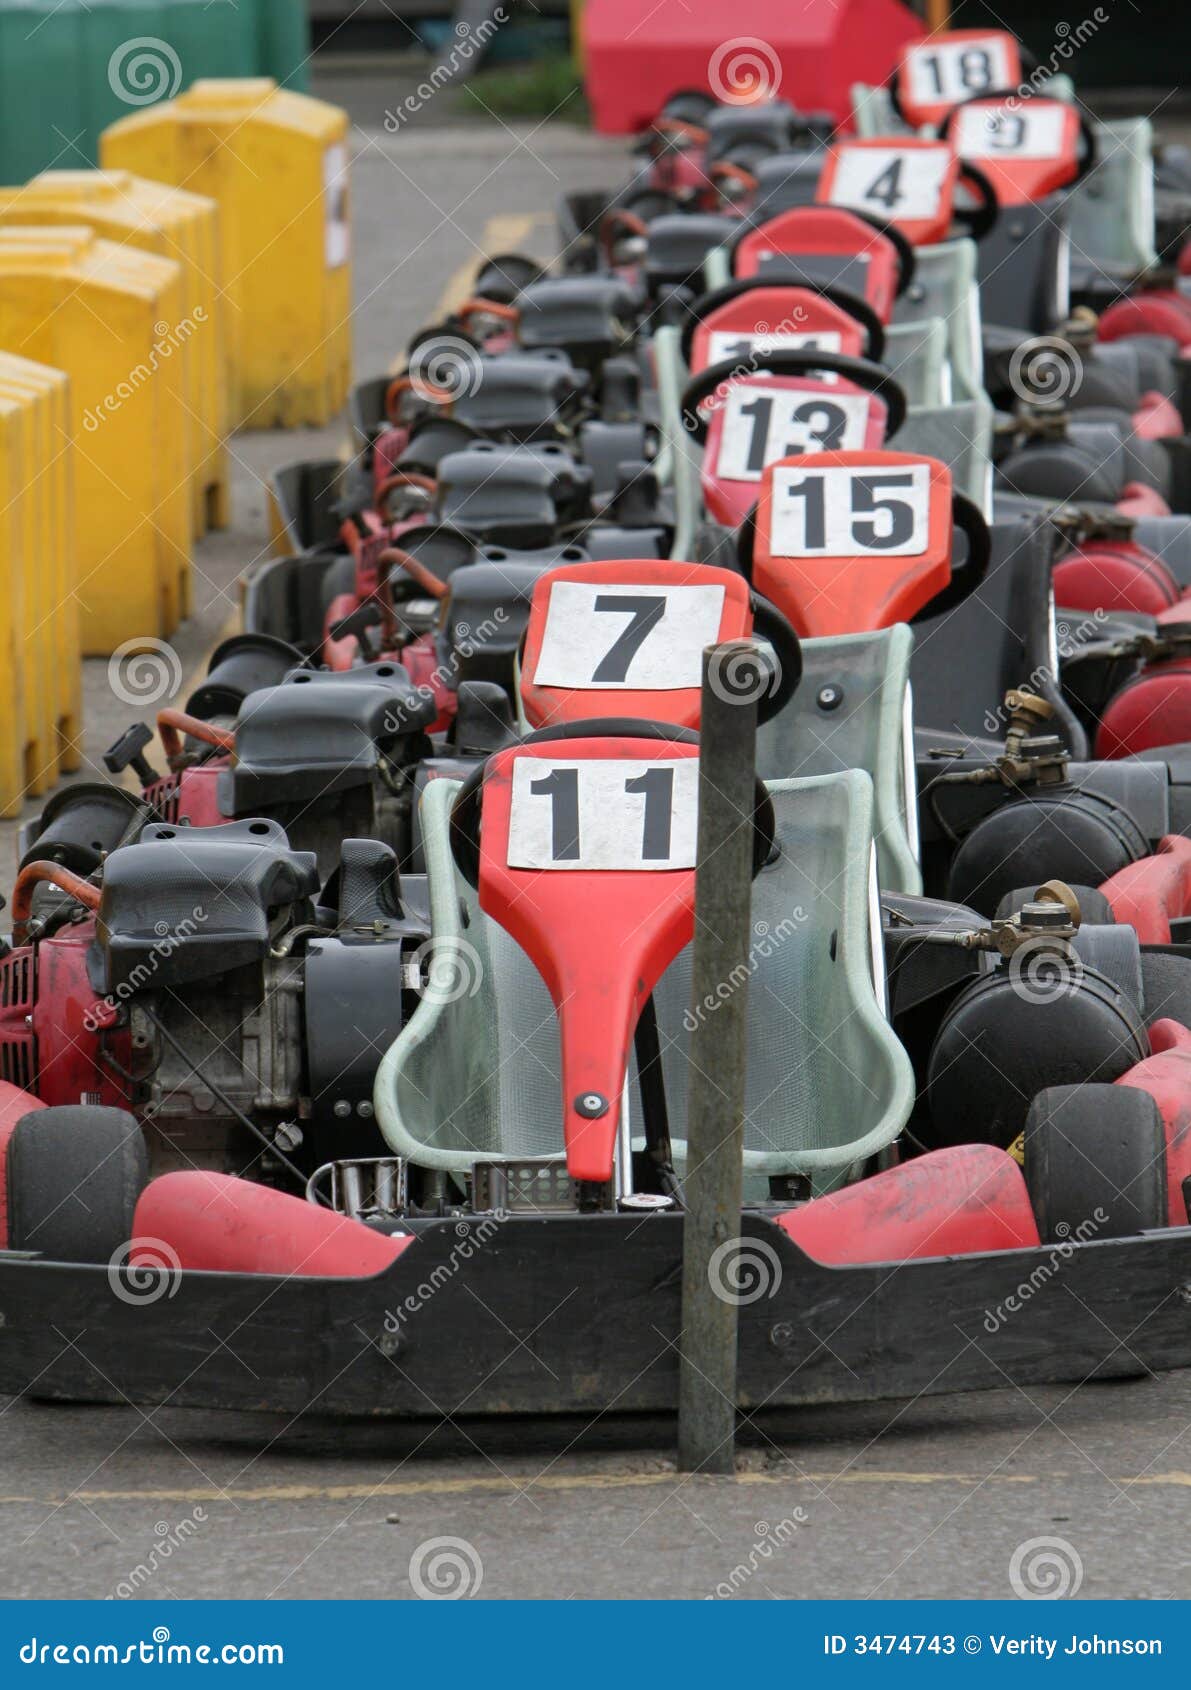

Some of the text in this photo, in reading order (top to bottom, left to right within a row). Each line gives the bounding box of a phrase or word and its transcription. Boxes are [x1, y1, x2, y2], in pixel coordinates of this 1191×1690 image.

[922, 48, 991, 95] 18
[987, 114, 1027, 149] 9
[864, 157, 905, 208] 4
[740, 397, 848, 472] 13
[787, 473, 915, 550] 15
[592, 594, 667, 683] 7
[530, 767, 675, 861] 11
